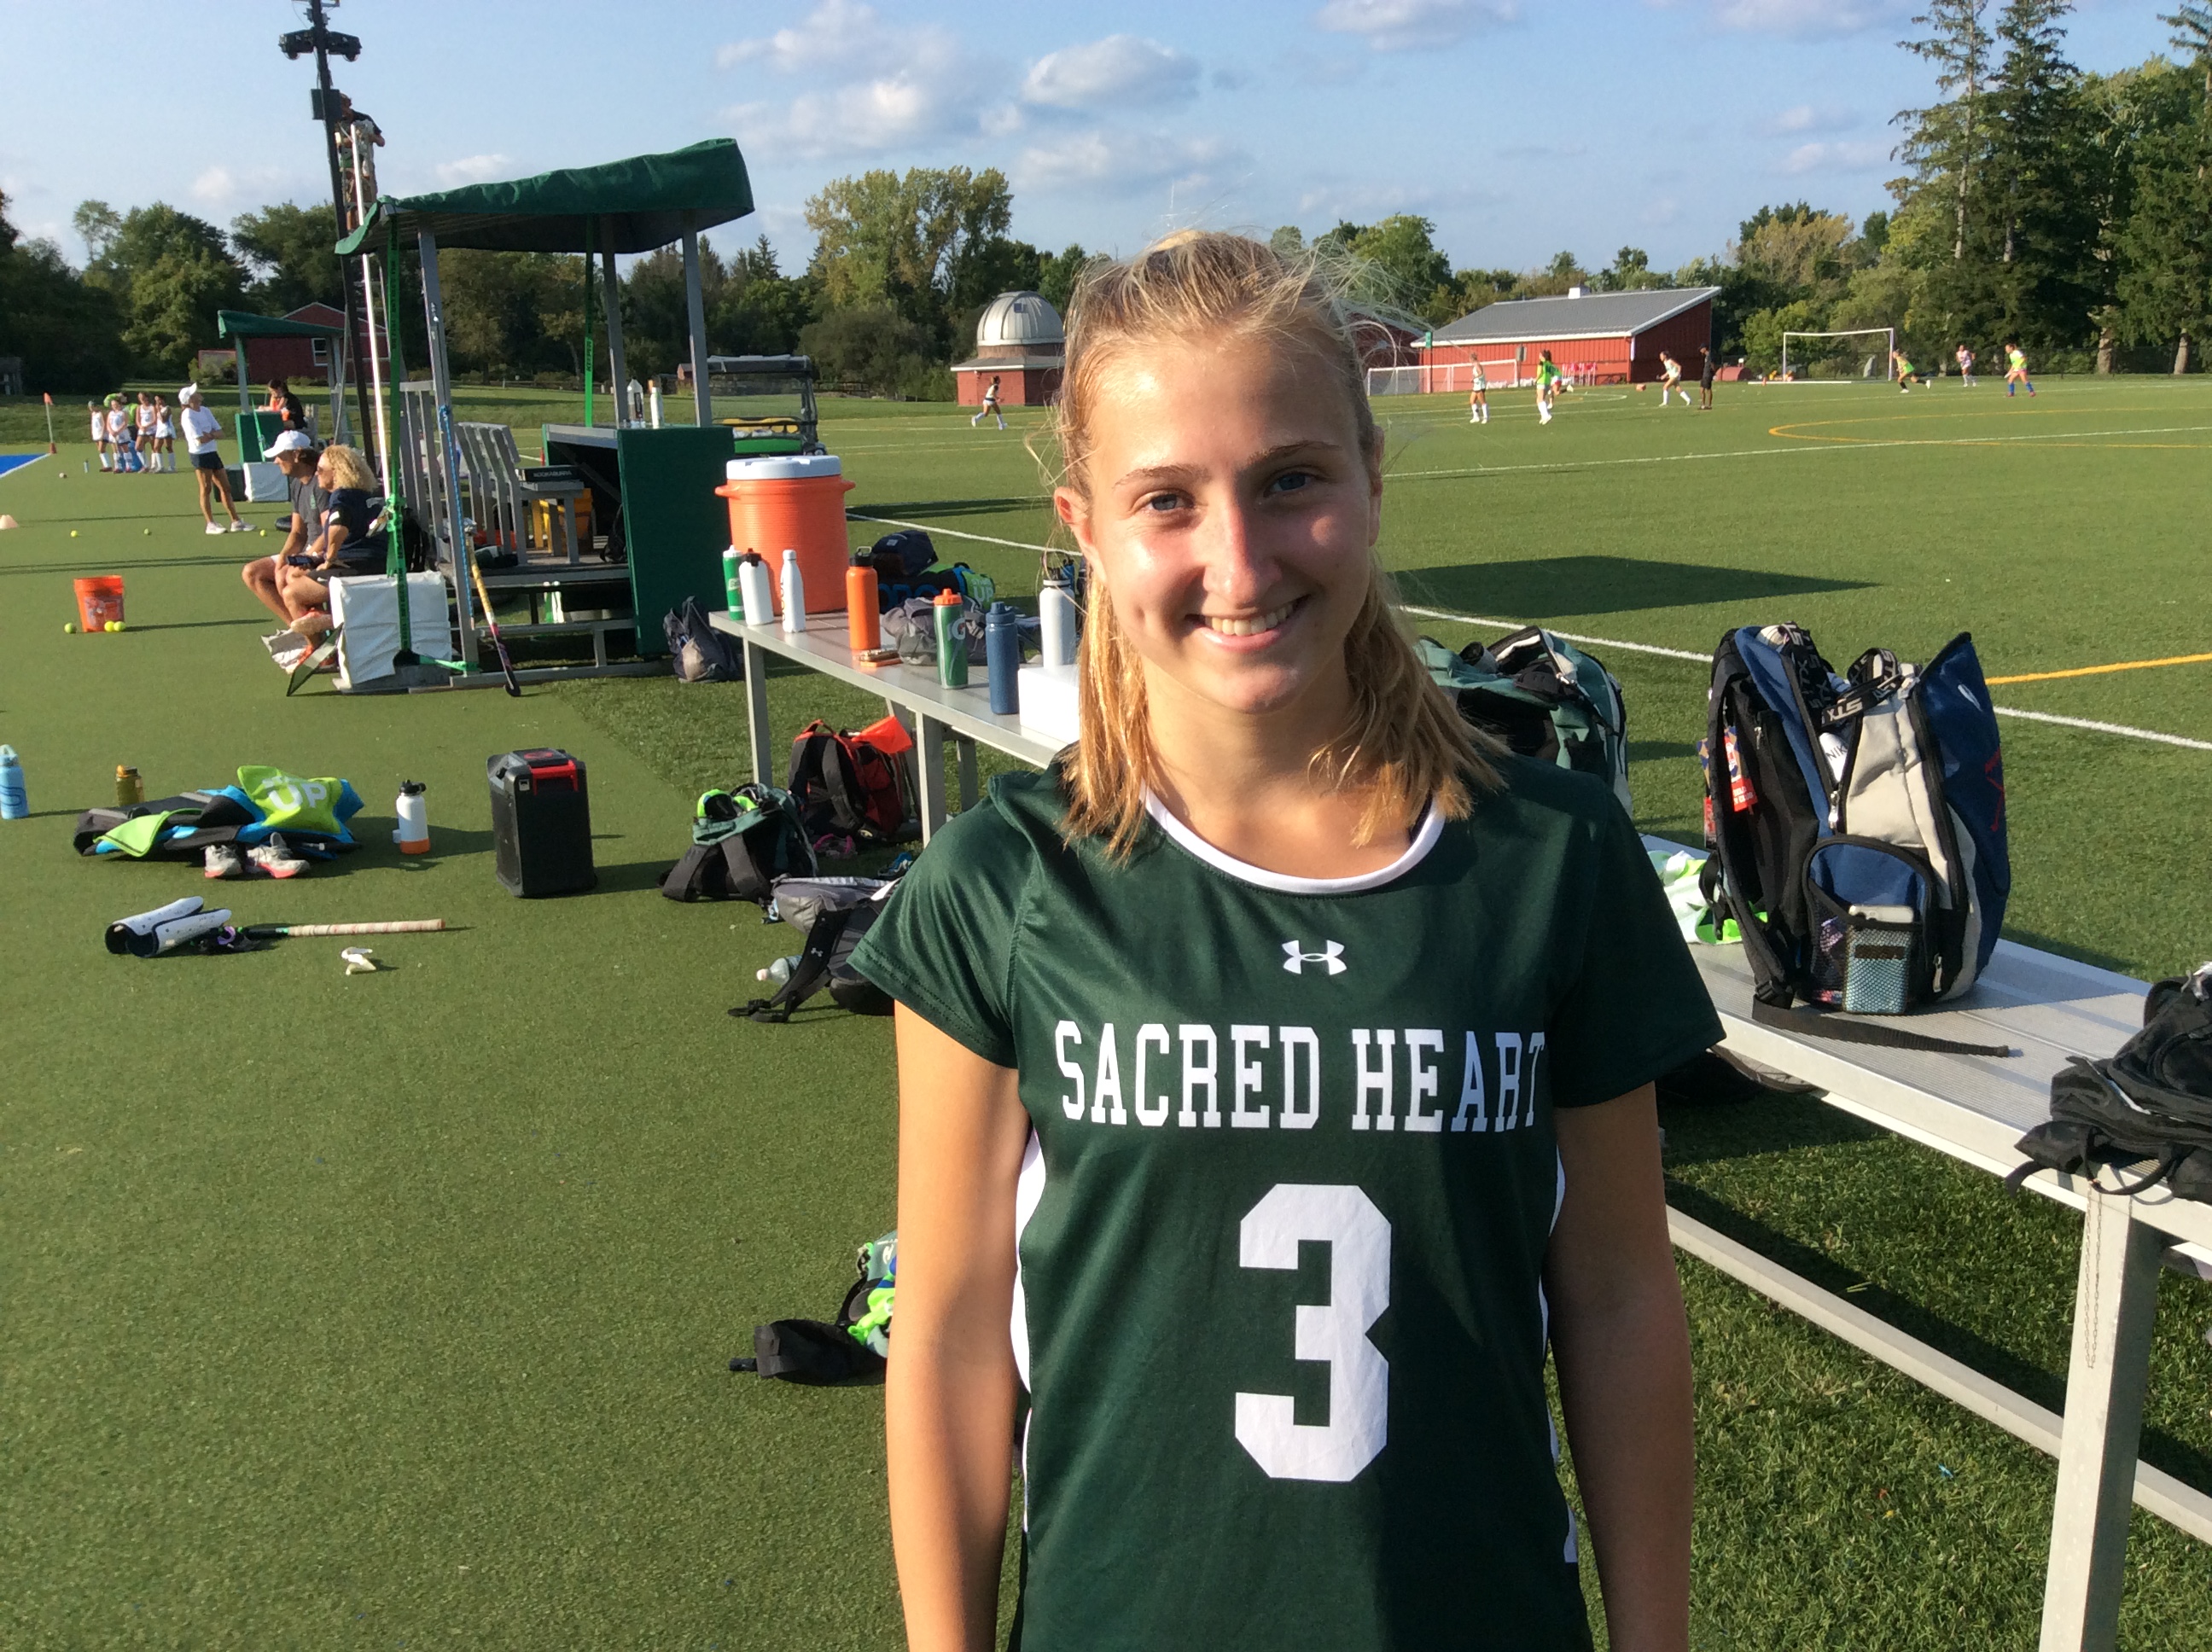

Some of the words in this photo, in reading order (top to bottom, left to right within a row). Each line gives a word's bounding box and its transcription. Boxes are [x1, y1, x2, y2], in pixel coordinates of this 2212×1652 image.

[973, 586, 994, 602] UP
[1826, 697, 1864, 722] STX
[1825, 745, 1848, 761] NIK
[268, 782, 327, 812] UP
[1055, 1021, 1320, 1129] SACRED
[1352, 1028, 1545, 1132] HEART
[1235, 1184, 1392, 1481] 3
